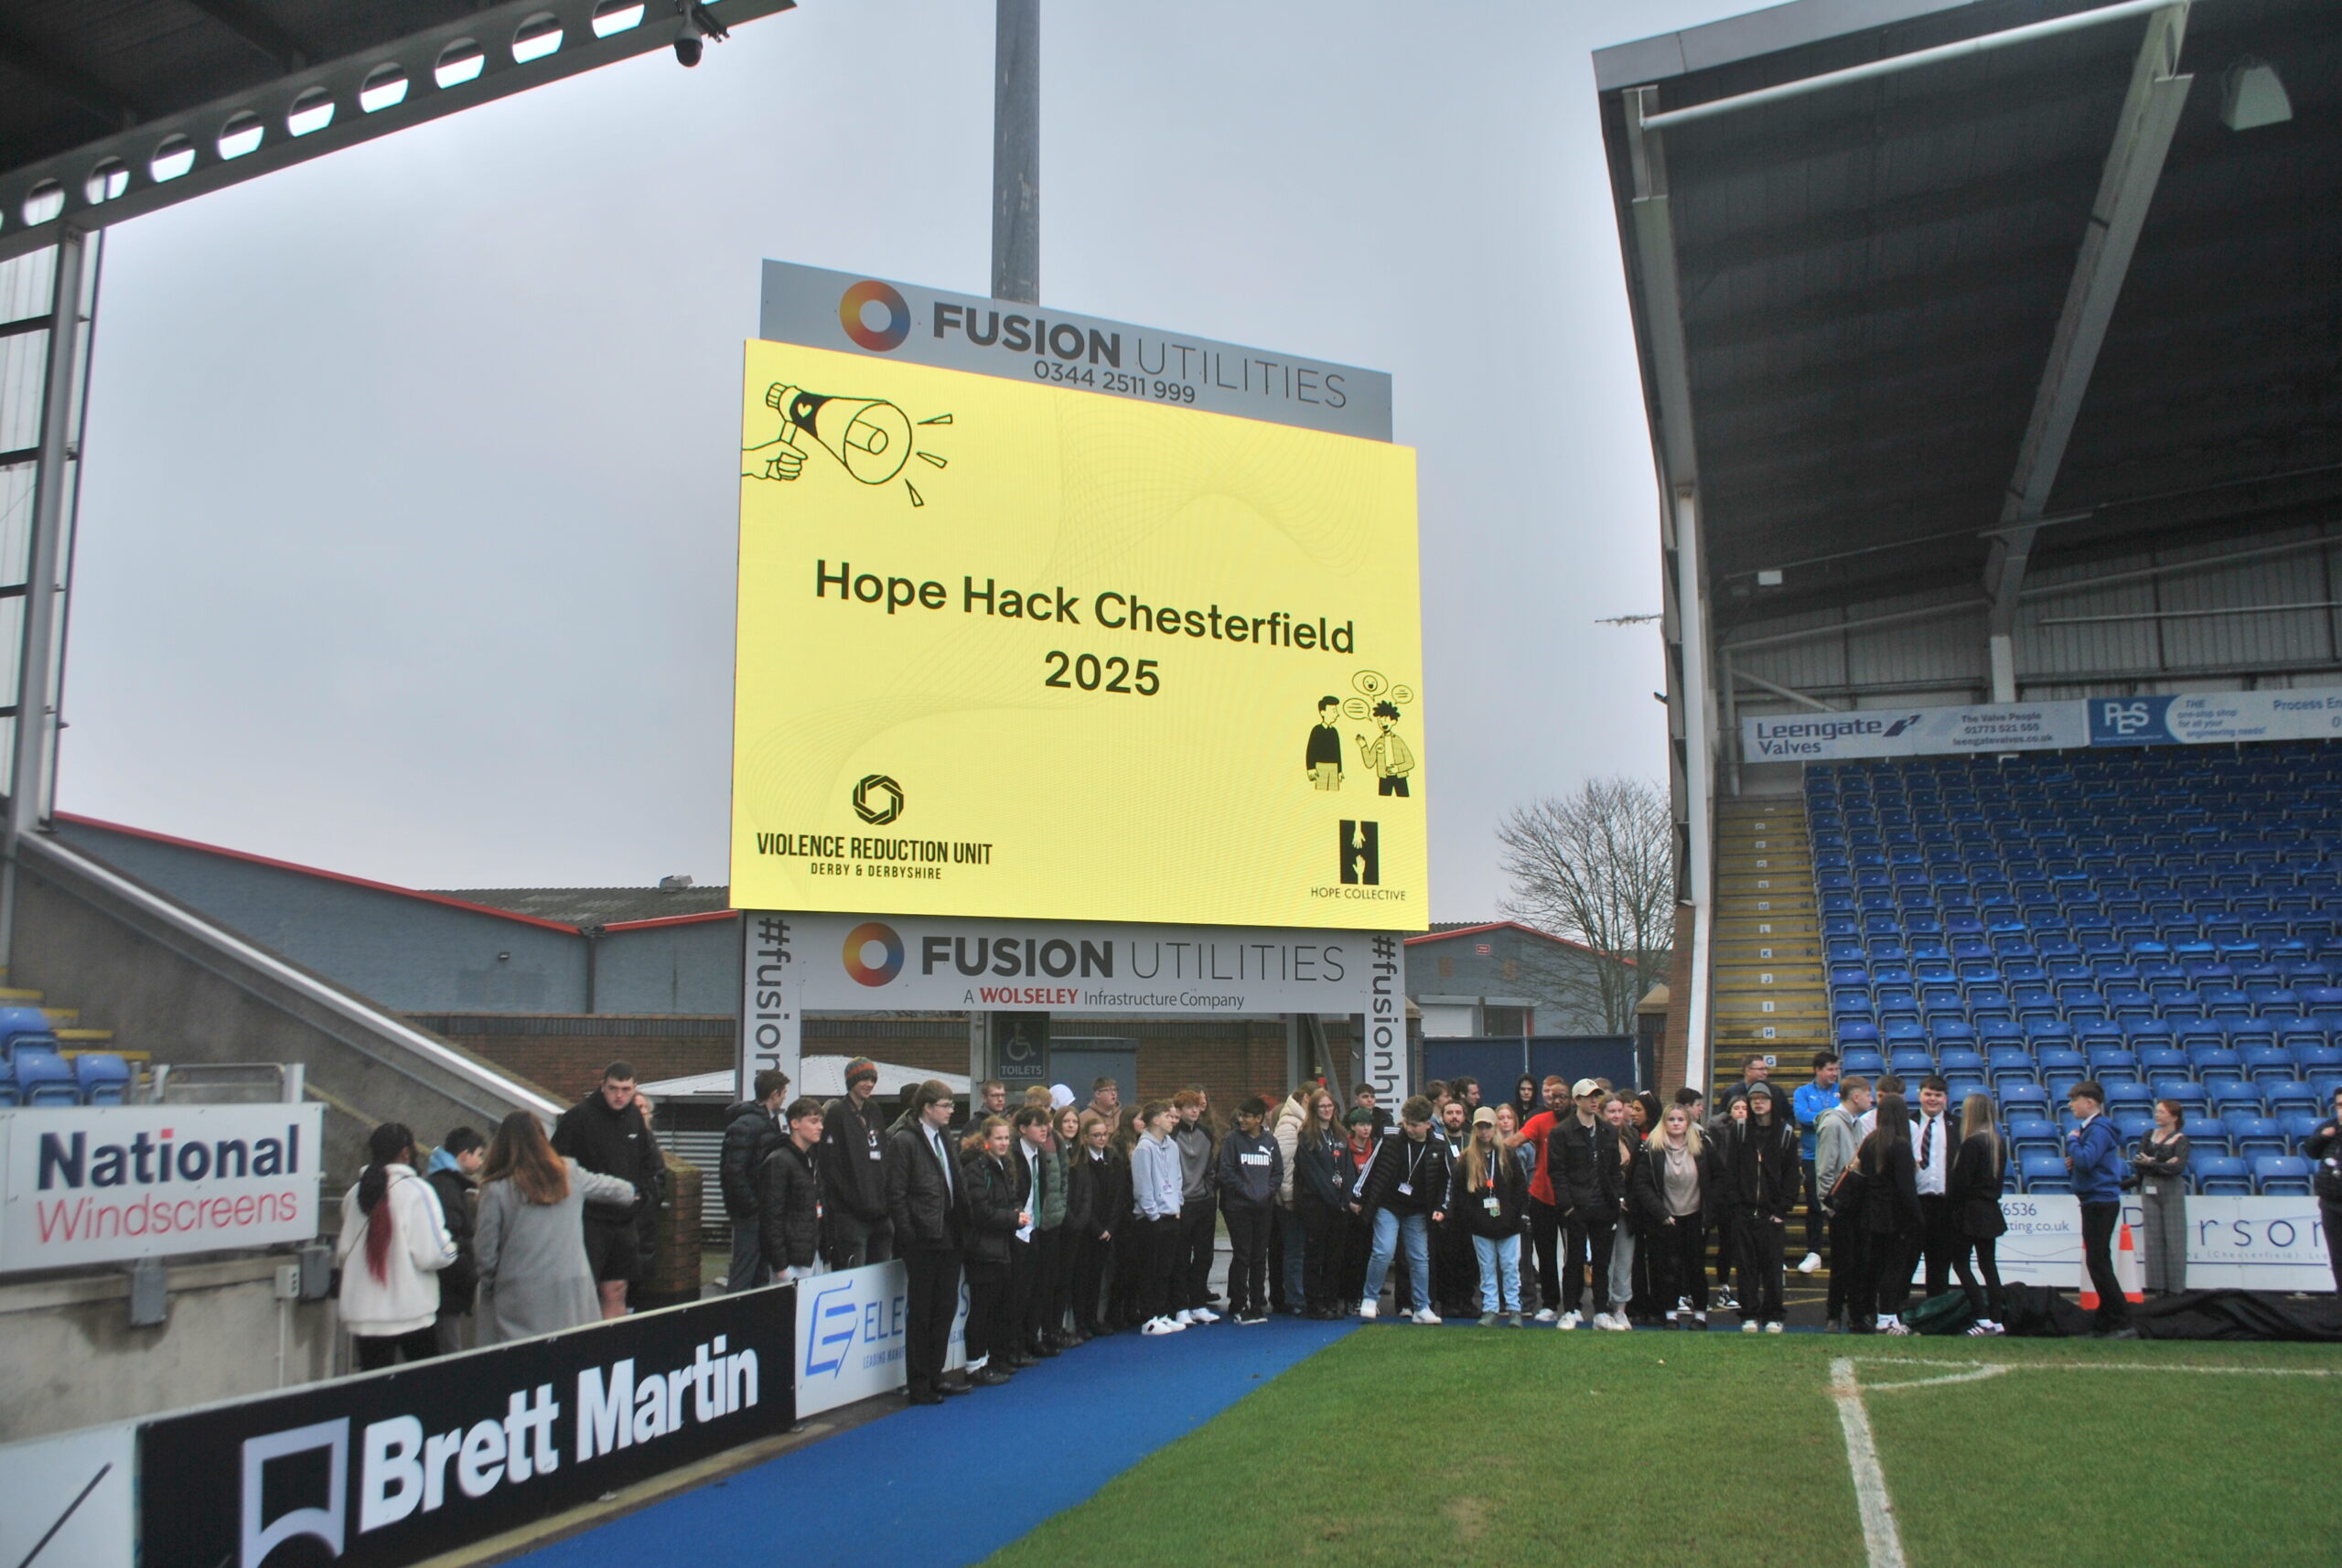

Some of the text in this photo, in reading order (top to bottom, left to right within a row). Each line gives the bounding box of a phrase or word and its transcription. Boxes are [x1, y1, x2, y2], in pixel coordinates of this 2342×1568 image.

[933, 301, 1348, 409] FUSION UTILITIES
[1033, 359, 1197, 405] 0344 2511 999
[815, 559, 1355, 654] Hope Hack Chesterfield
[1045, 650, 1160, 696] 2025
[1756, 717, 1883, 741] Leengate
[1757, 739, 1821, 756] Valves
[757, 832, 993, 865] VIOLENCE REDUCTION UNIT
[811, 862, 942, 880] DERBY & DERBYSHIRE
[1311, 886, 1406, 901] HOPE COLLECTIVE
[921, 936, 1345, 983] FUSION UTILITIES
[755, 917, 792, 1077] #fusion
[963, 987, 1245, 1011] A WOLSELEY Infrastructure Company
[1000, 1064, 1043, 1077] TOILETS
[38, 1123, 300, 1190] National
[1241, 1153, 1270, 1166] PUMA
[37, 1191, 298, 1244] Windscreens
[1999, 1202, 2037, 1217] 6536
[2006, 1219, 2070, 1234] ting.co.uk
[2207, 1251, 2299, 1260] (Chesterfield)
[864, 1295, 908, 1344] ELE
[358, 1334, 758, 1534] Brett Martin
